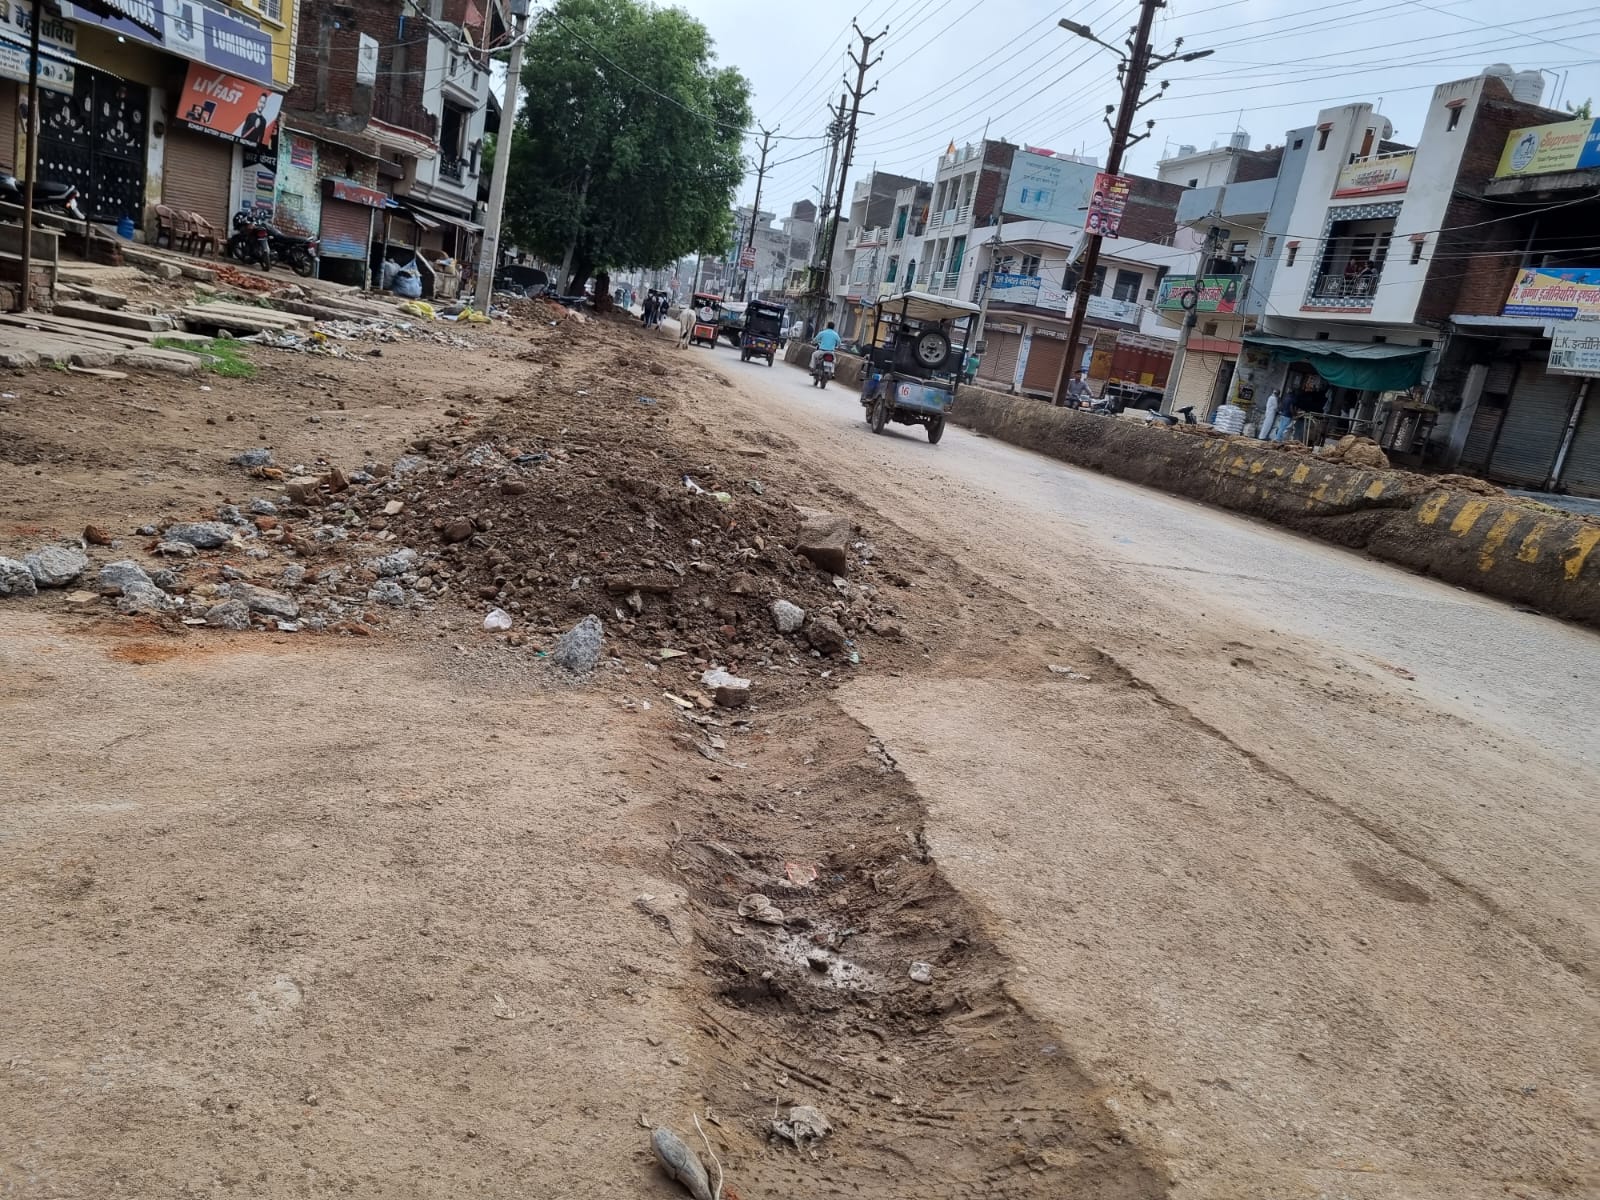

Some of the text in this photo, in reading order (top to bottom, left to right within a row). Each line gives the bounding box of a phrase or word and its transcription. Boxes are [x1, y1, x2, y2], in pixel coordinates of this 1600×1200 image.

[212, 27, 266, 66] LUMINOUS
[193, 74, 244, 104] LIVFAST
[1554, 336, 1570, 349] L.K.
[901, 386, 909, 396] 16
